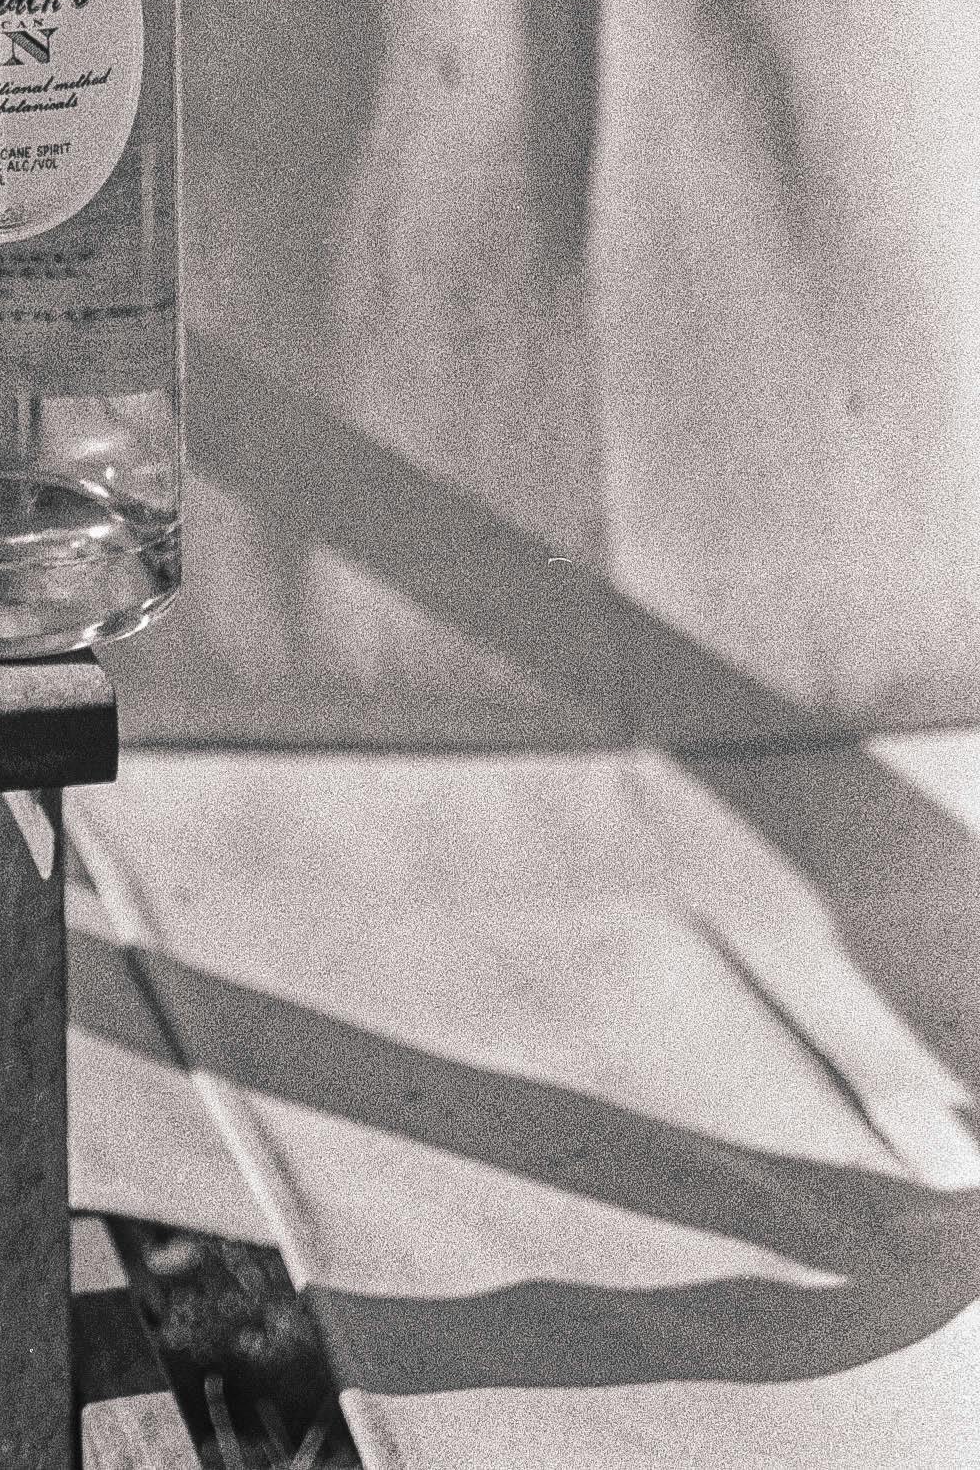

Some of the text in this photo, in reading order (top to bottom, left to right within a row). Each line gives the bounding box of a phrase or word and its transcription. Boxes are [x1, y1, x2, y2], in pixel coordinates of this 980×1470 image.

[53, 67, 112, 92] method
[0, 146, 32, 161] CANE
[36, 142, 72, 157] SPIRIT
